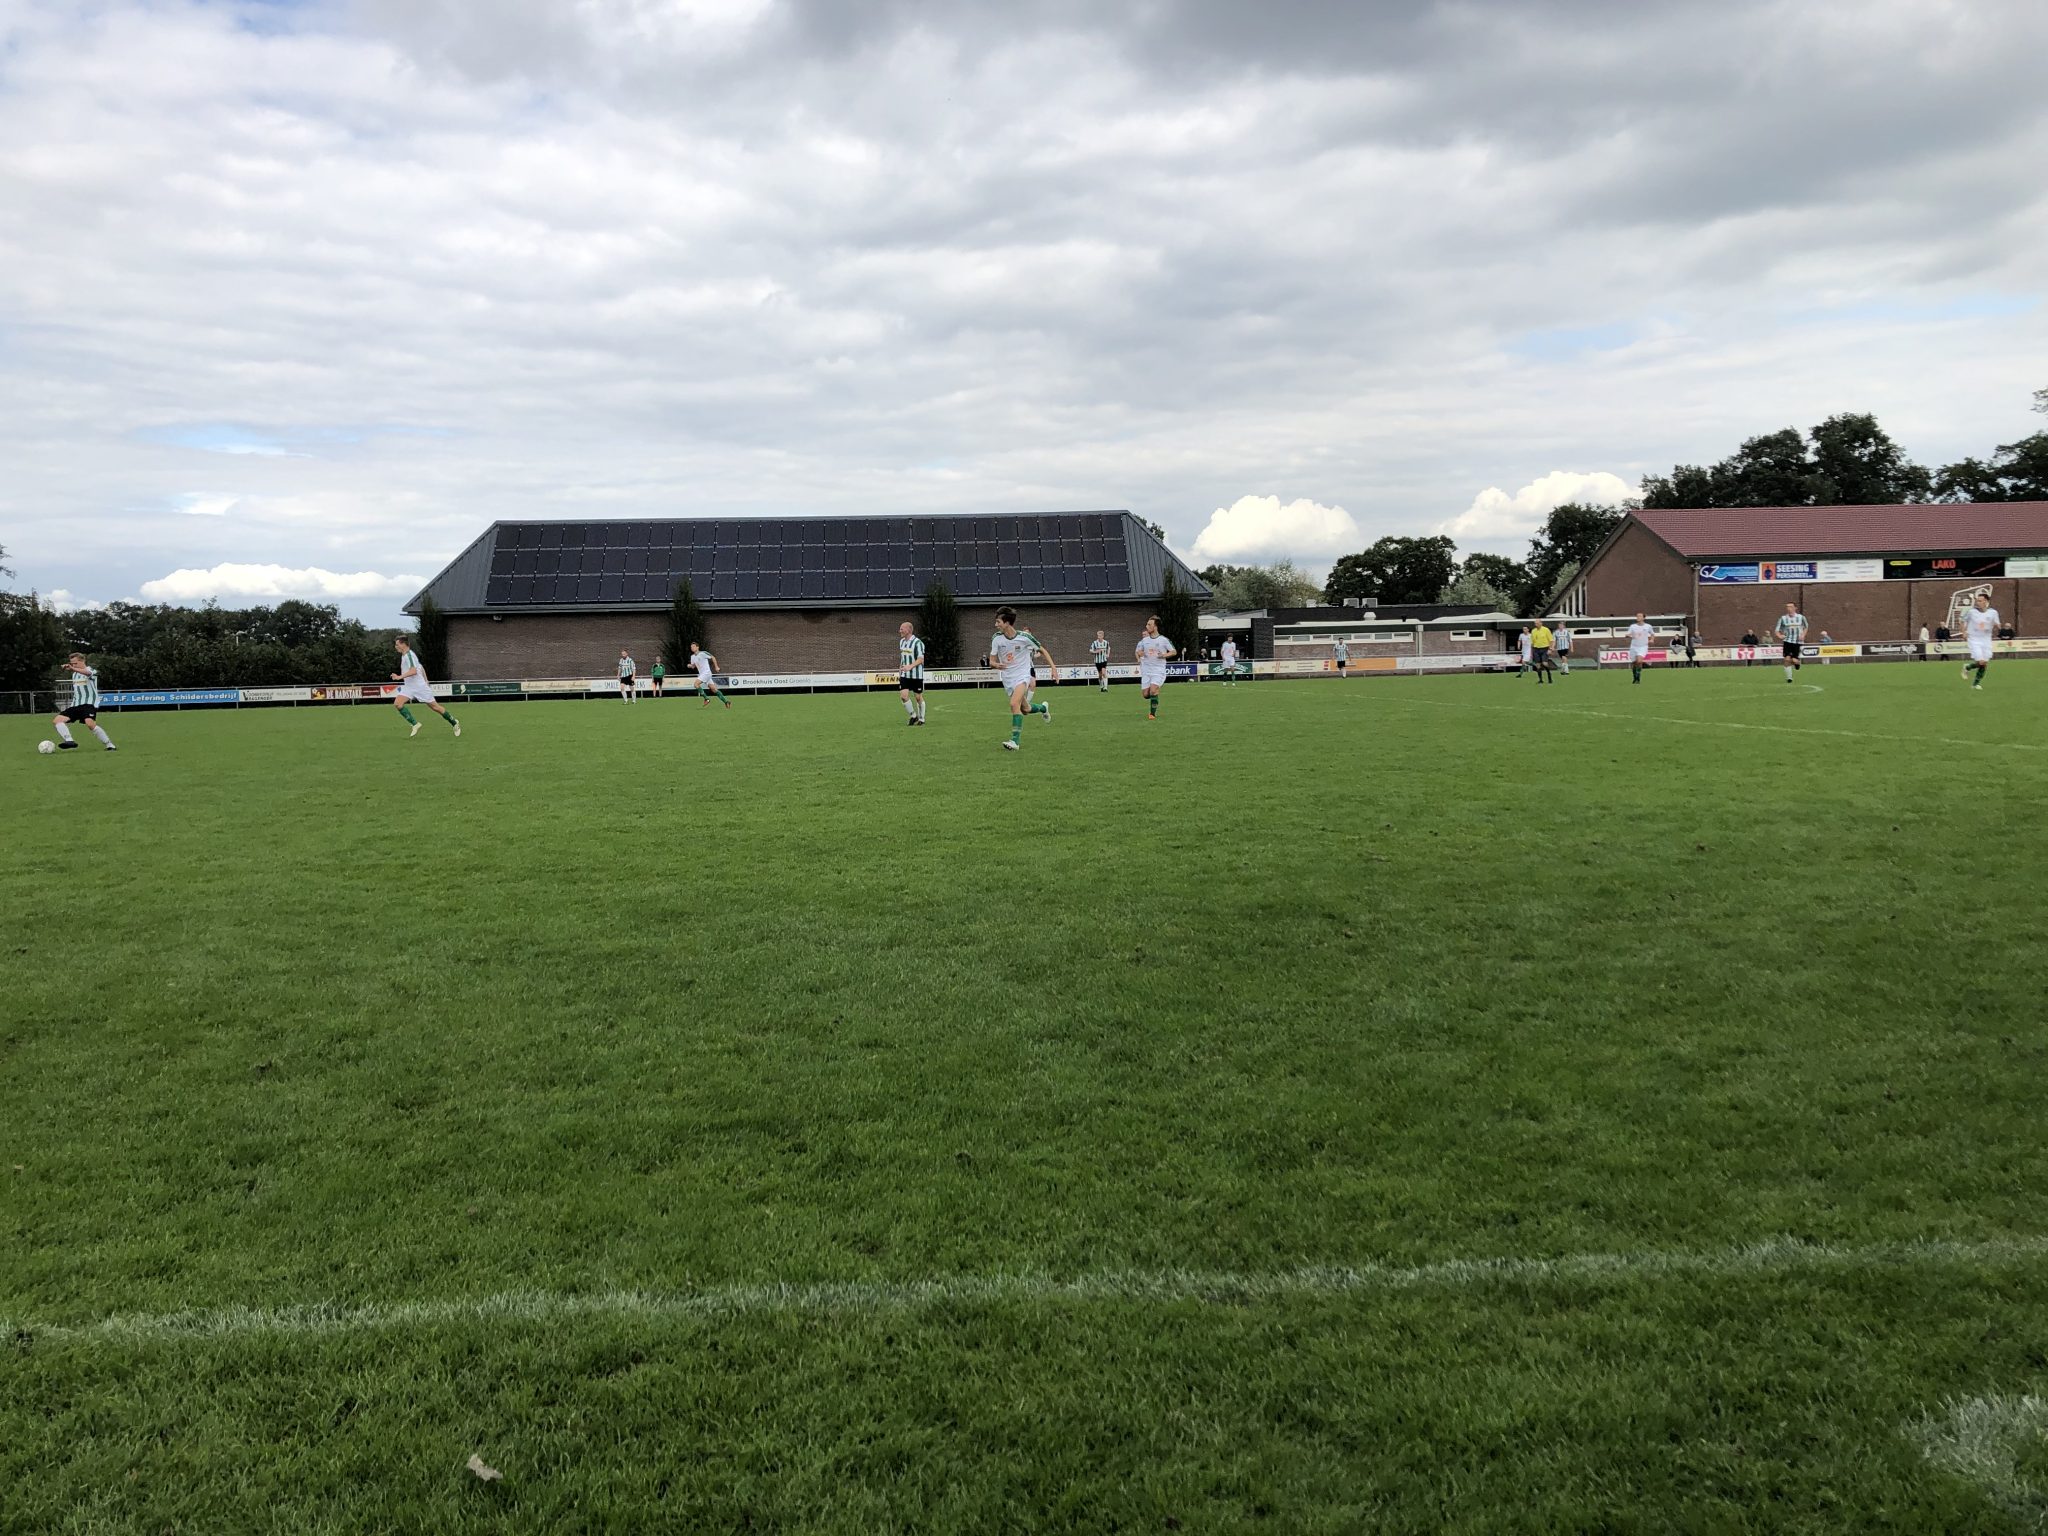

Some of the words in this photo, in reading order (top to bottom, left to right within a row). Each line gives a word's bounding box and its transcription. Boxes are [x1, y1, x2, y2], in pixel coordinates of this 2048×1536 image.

[1776, 564, 1810, 573] SEESING
[1601, 652, 1632, 661] JAR
[1165, 666, 1191, 675] obank
